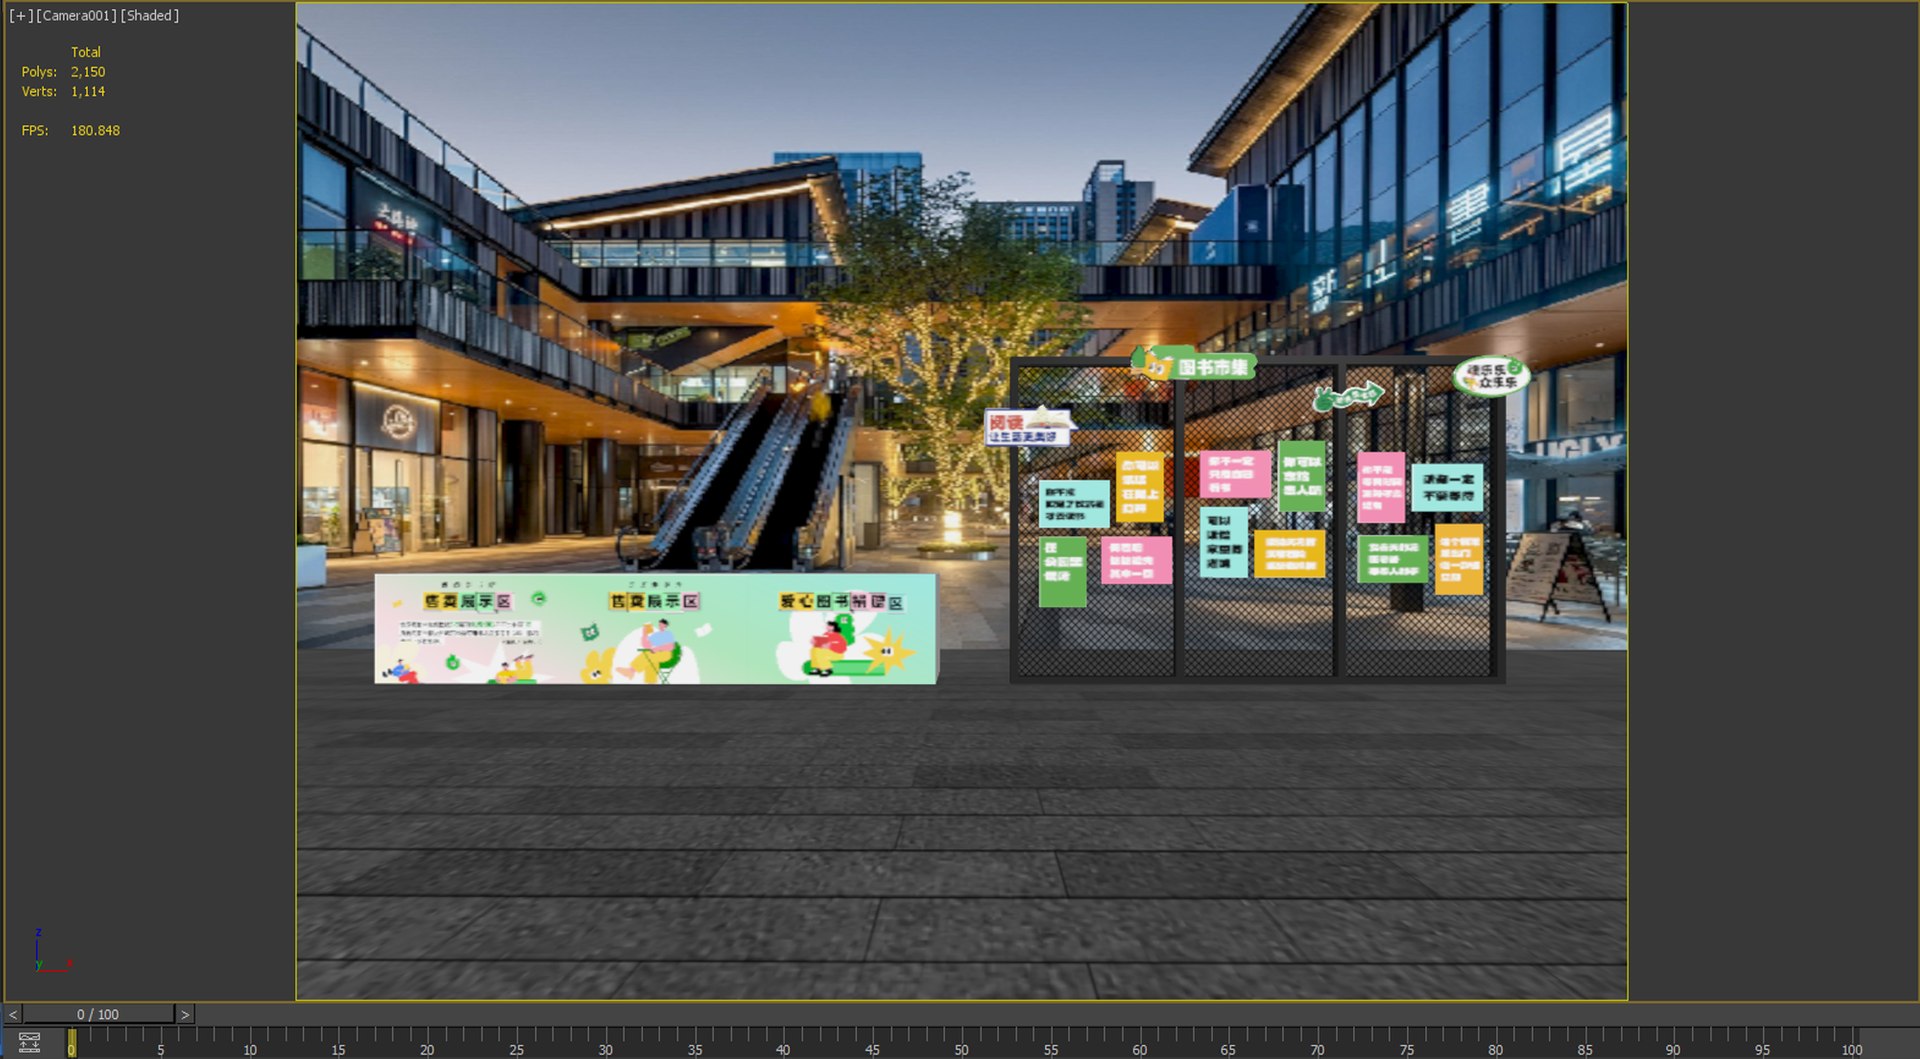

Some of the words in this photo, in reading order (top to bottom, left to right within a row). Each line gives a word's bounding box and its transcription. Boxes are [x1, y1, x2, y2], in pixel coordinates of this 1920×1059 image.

[37, 8, 117, 24] [Camera001]
[121, 8, 179, 24] [Shaded]
[71, 46, 101, 58] Total
[21, 65, 57, 79] Polys:
[71, 66, 106, 79] 2,150
[21, 86, 57, 97] Verts:
[71, 86, 106, 98] 1,114
[21, 124, 49, 136] FPS:
[71, 124, 121, 136] 180.848
[1178, 358, 1249, 376] 图书市集
[989, 414, 1024, 430] 阅读
[76, 1008, 85, 1021] 0
[98, 1008, 120, 1021] 100
[67, 1044, 75, 1056] 0
[157, 1044, 165, 1056] 5
[244, 1044, 257, 1056] 10
[332, 1044, 346, 1056] 15
[420, 1044, 435, 1056] 20
[509, 1044, 524, 1056] 25
[599, 1044, 613, 1056] 30
[688, 1044, 703, 1056] 35
[775, 1044, 791, 1056] 40
[865, 1044, 880, 1056] 45
[955, 1044, 969, 1056] 50
[1044, 1044, 1059, 1056] 55
[1132, 1044, 1148, 1056] 60
[1220, 1044, 1236, 1056] 65
[1311, 1044, 1325, 1056] 70
[1400, 1044, 1415, 1056] 75
[1488, 1044, 1504, 1056] 80
[1577, 1044, 1593, 1056] 85
[1665, 1044, 1681, 1056] 90
[1755, 1044, 1770, 1056] 95
[1842, 1044, 1863, 1056] 100
